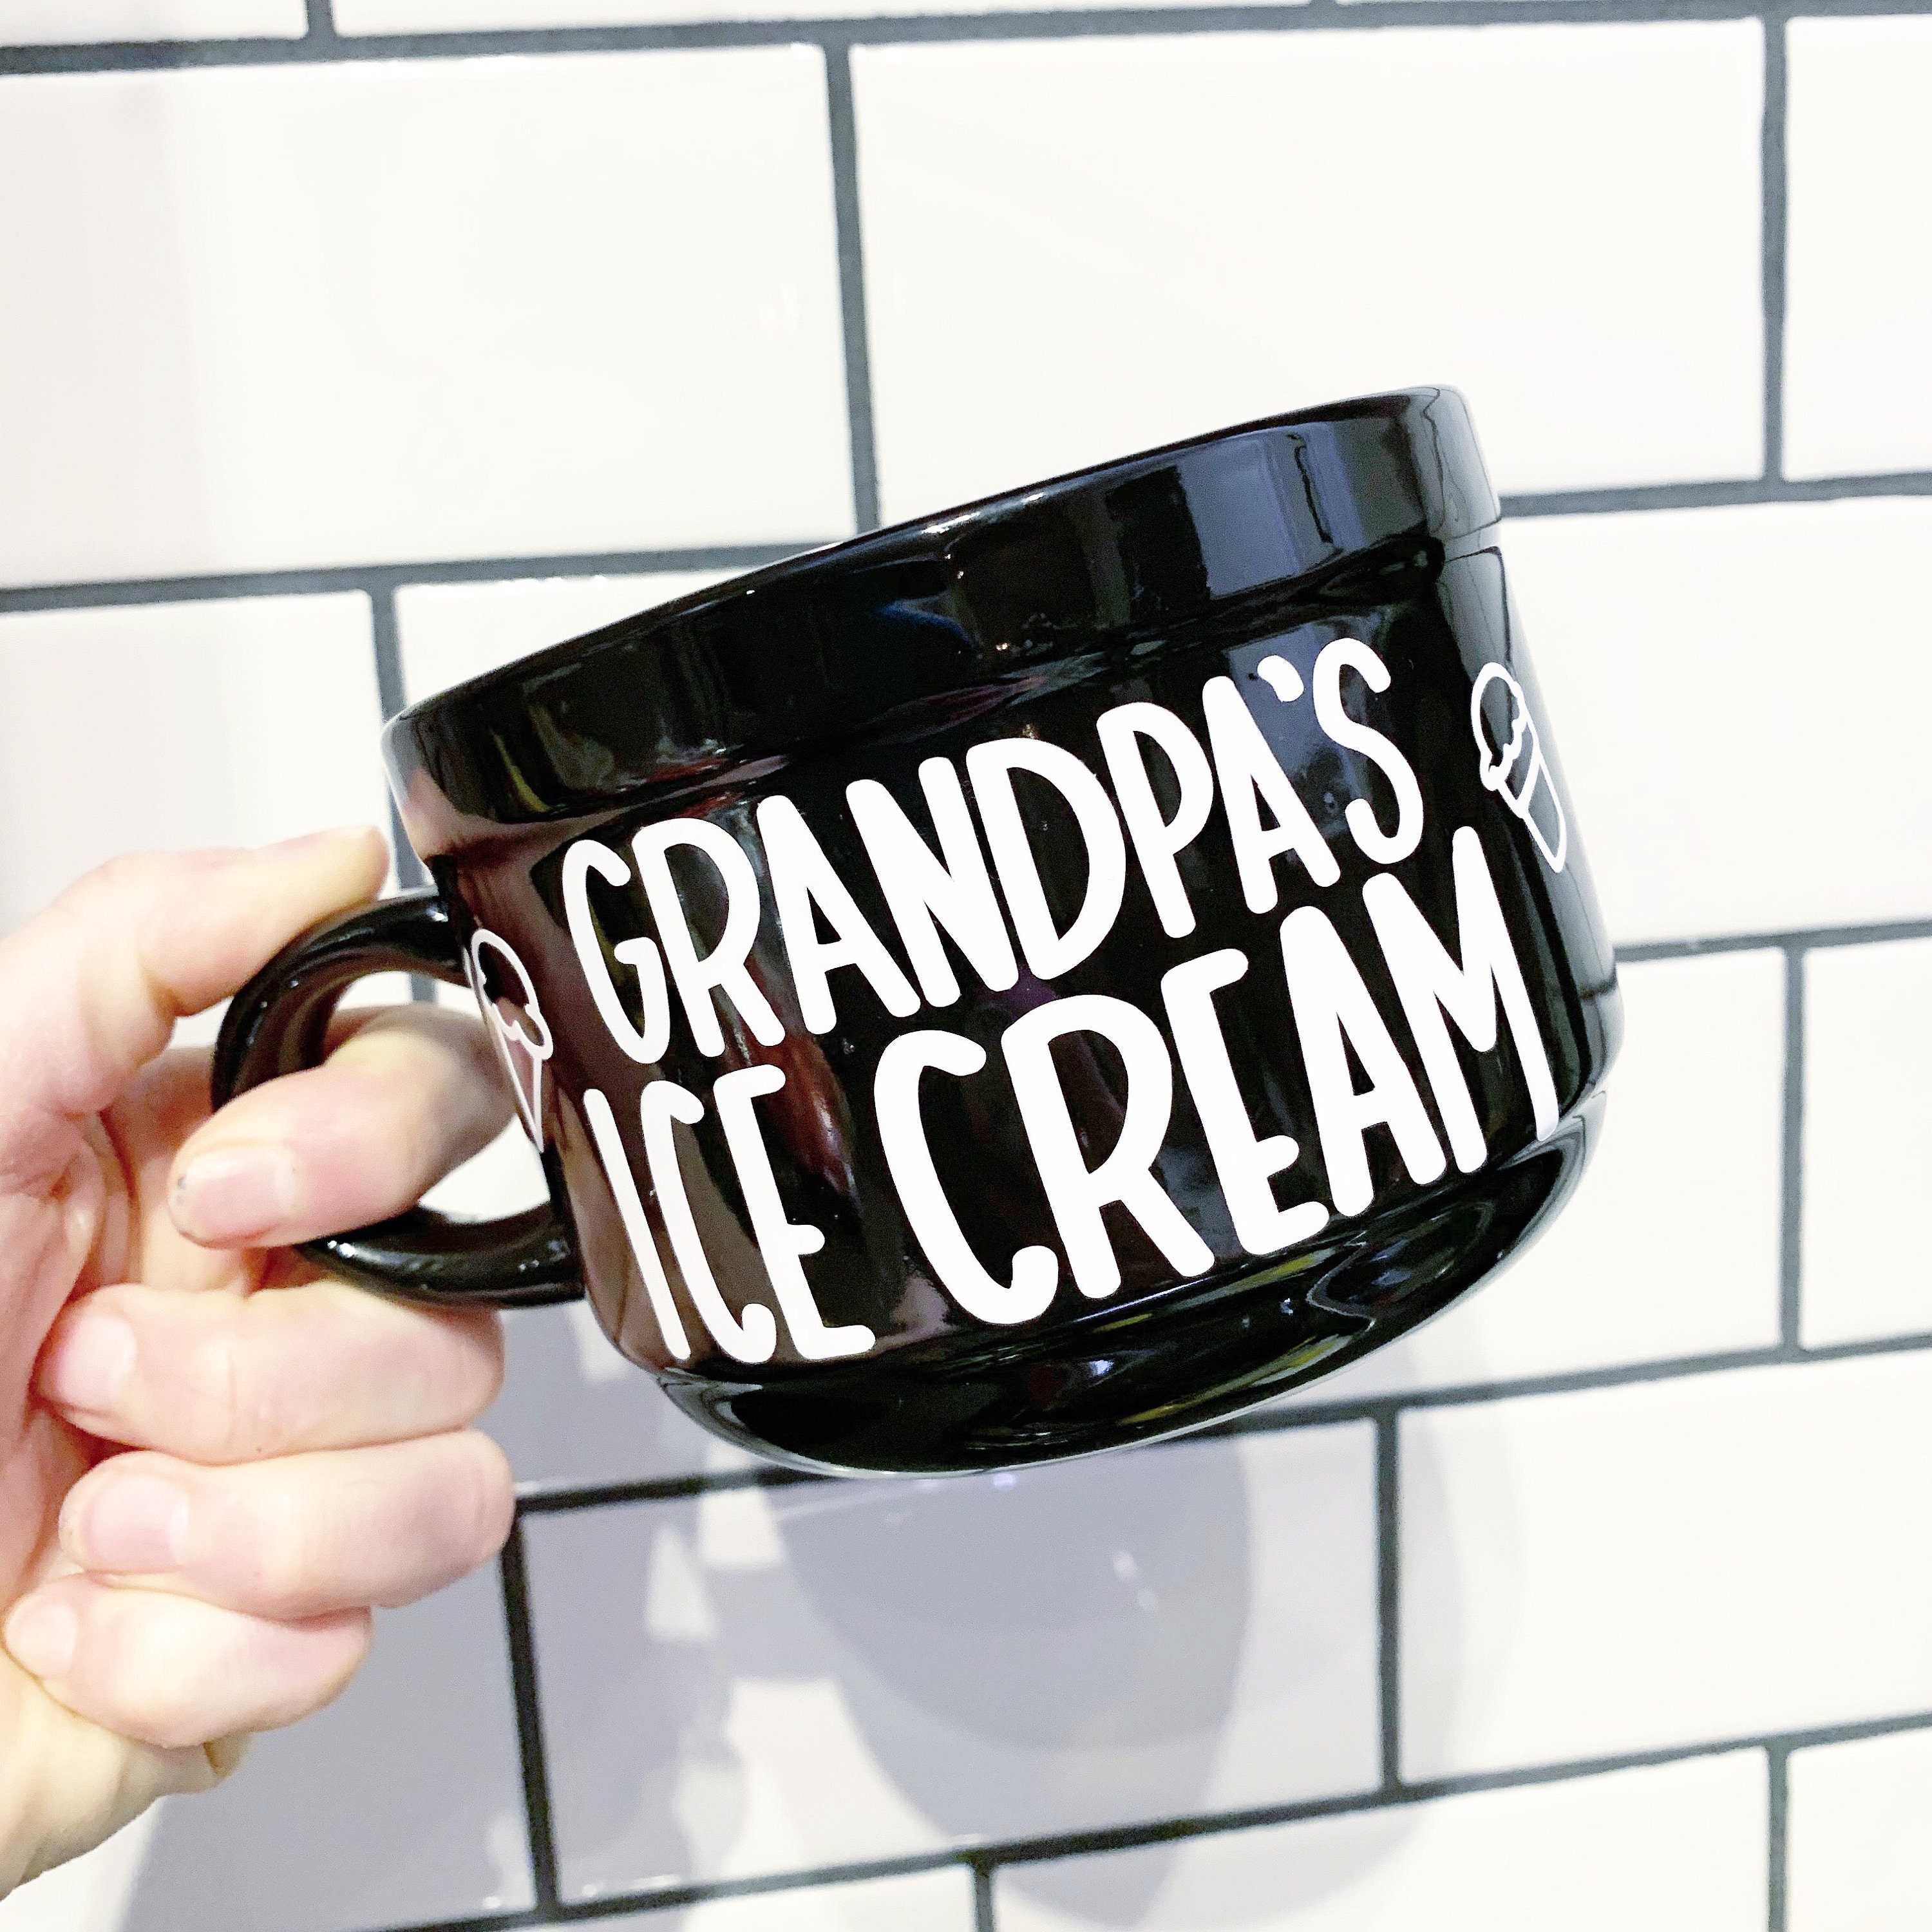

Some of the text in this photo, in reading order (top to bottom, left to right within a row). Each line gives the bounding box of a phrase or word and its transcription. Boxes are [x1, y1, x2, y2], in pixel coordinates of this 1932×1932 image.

[562, 638, 1425, 1065] GRANDPA'S
[583, 826, 1558, 1364] ICE CREAM
